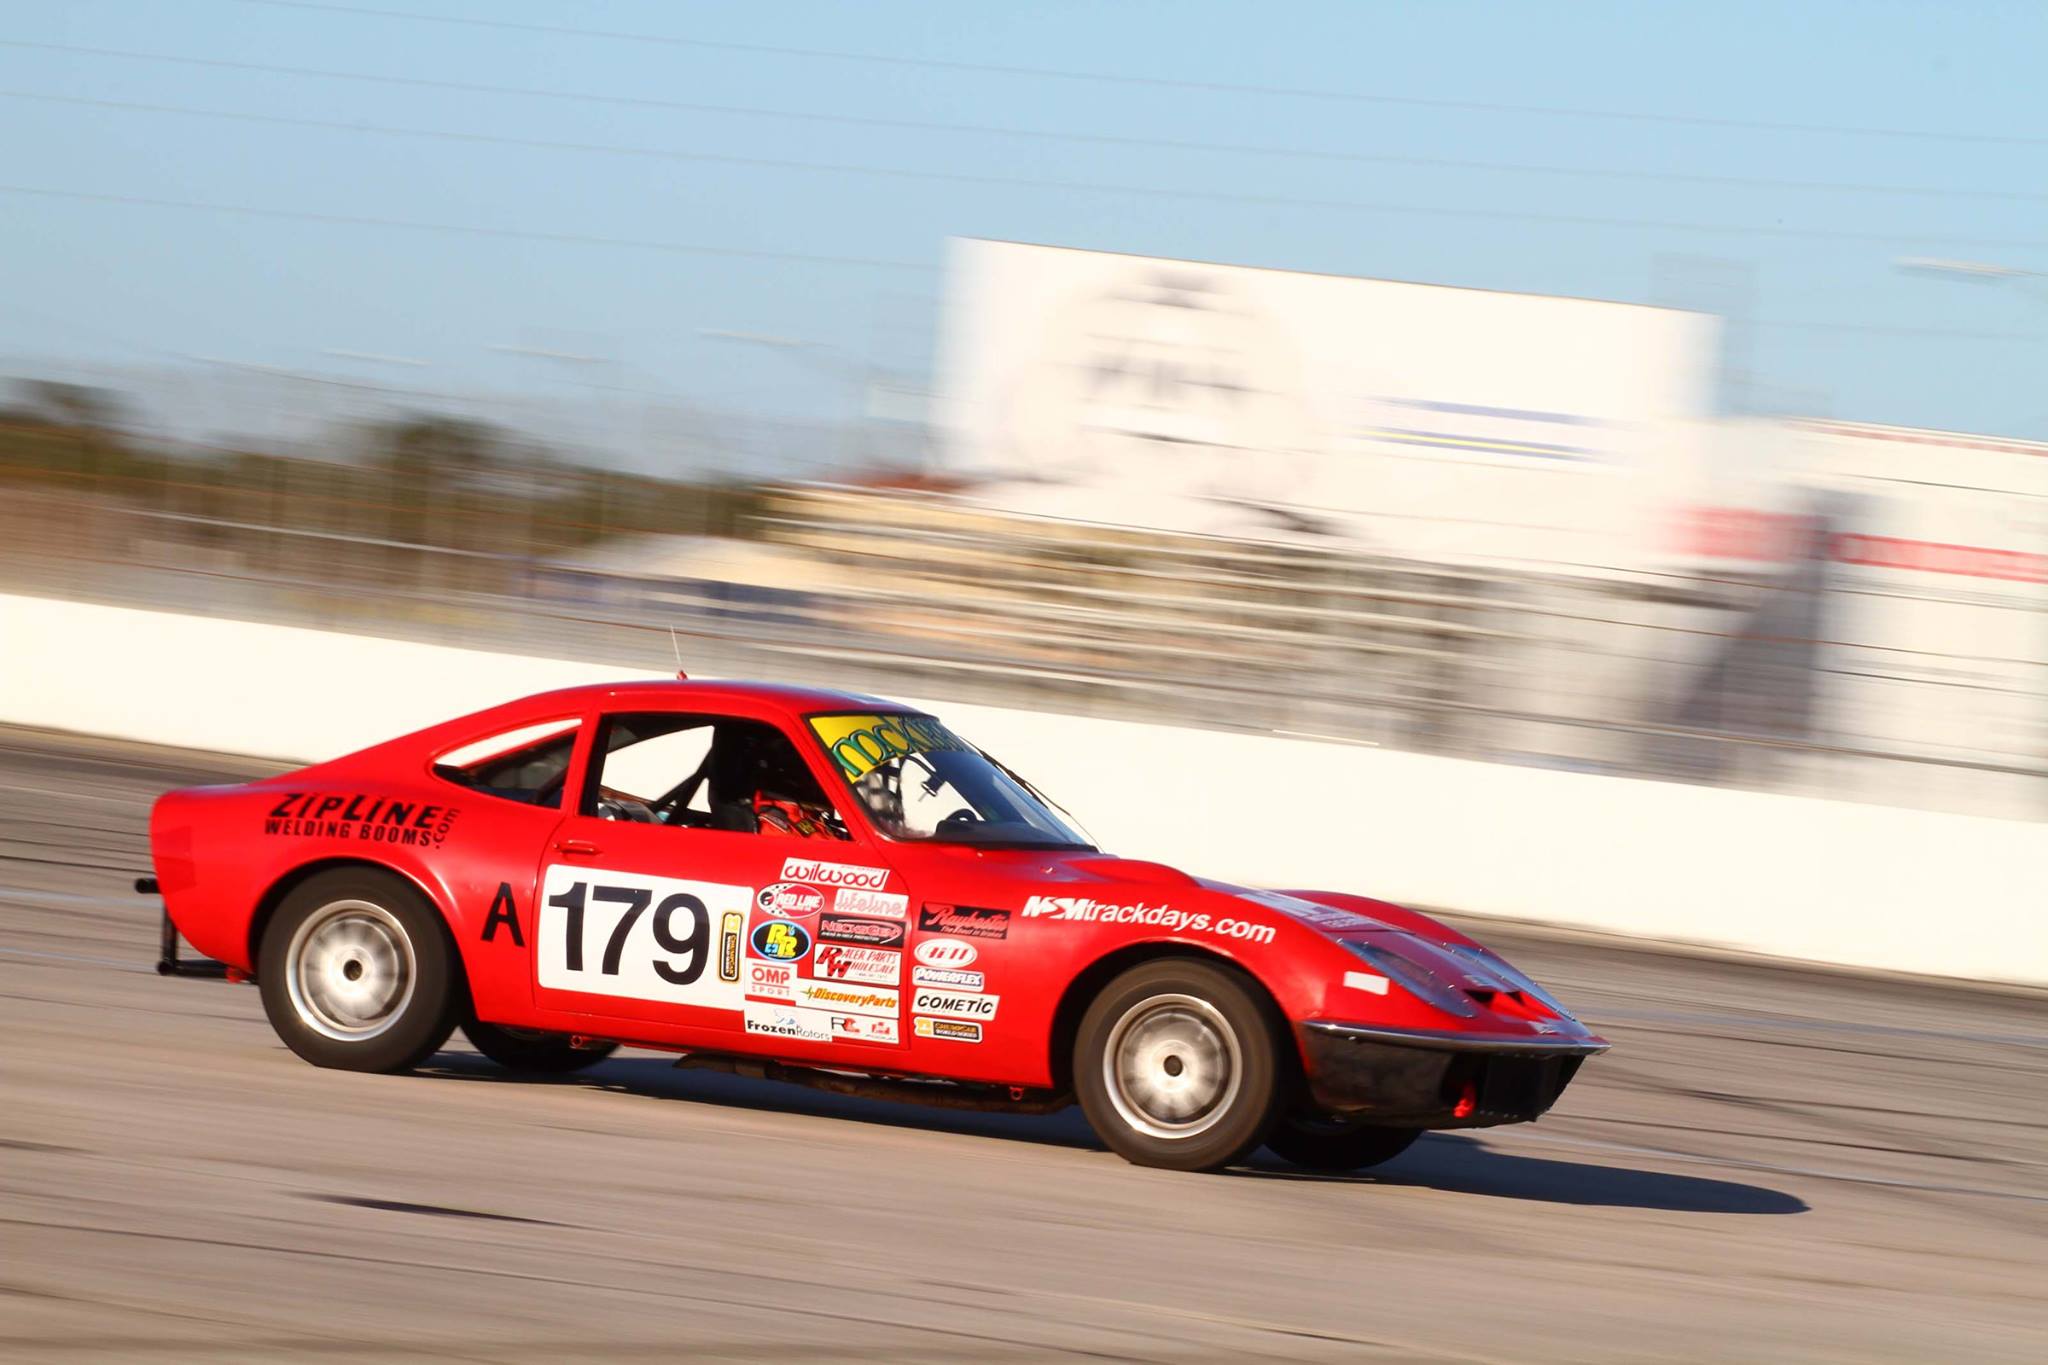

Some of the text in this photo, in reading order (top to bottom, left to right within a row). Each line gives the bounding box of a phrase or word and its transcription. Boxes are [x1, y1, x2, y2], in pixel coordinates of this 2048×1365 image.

[264, 819, 432, 847] WELDING BOOMS
[784, 863, 886, 888] wilwood
[480, 881, 525, 947] A
[548, 881, 711, 986] 179
[752, 968, 790, 983] OMP
